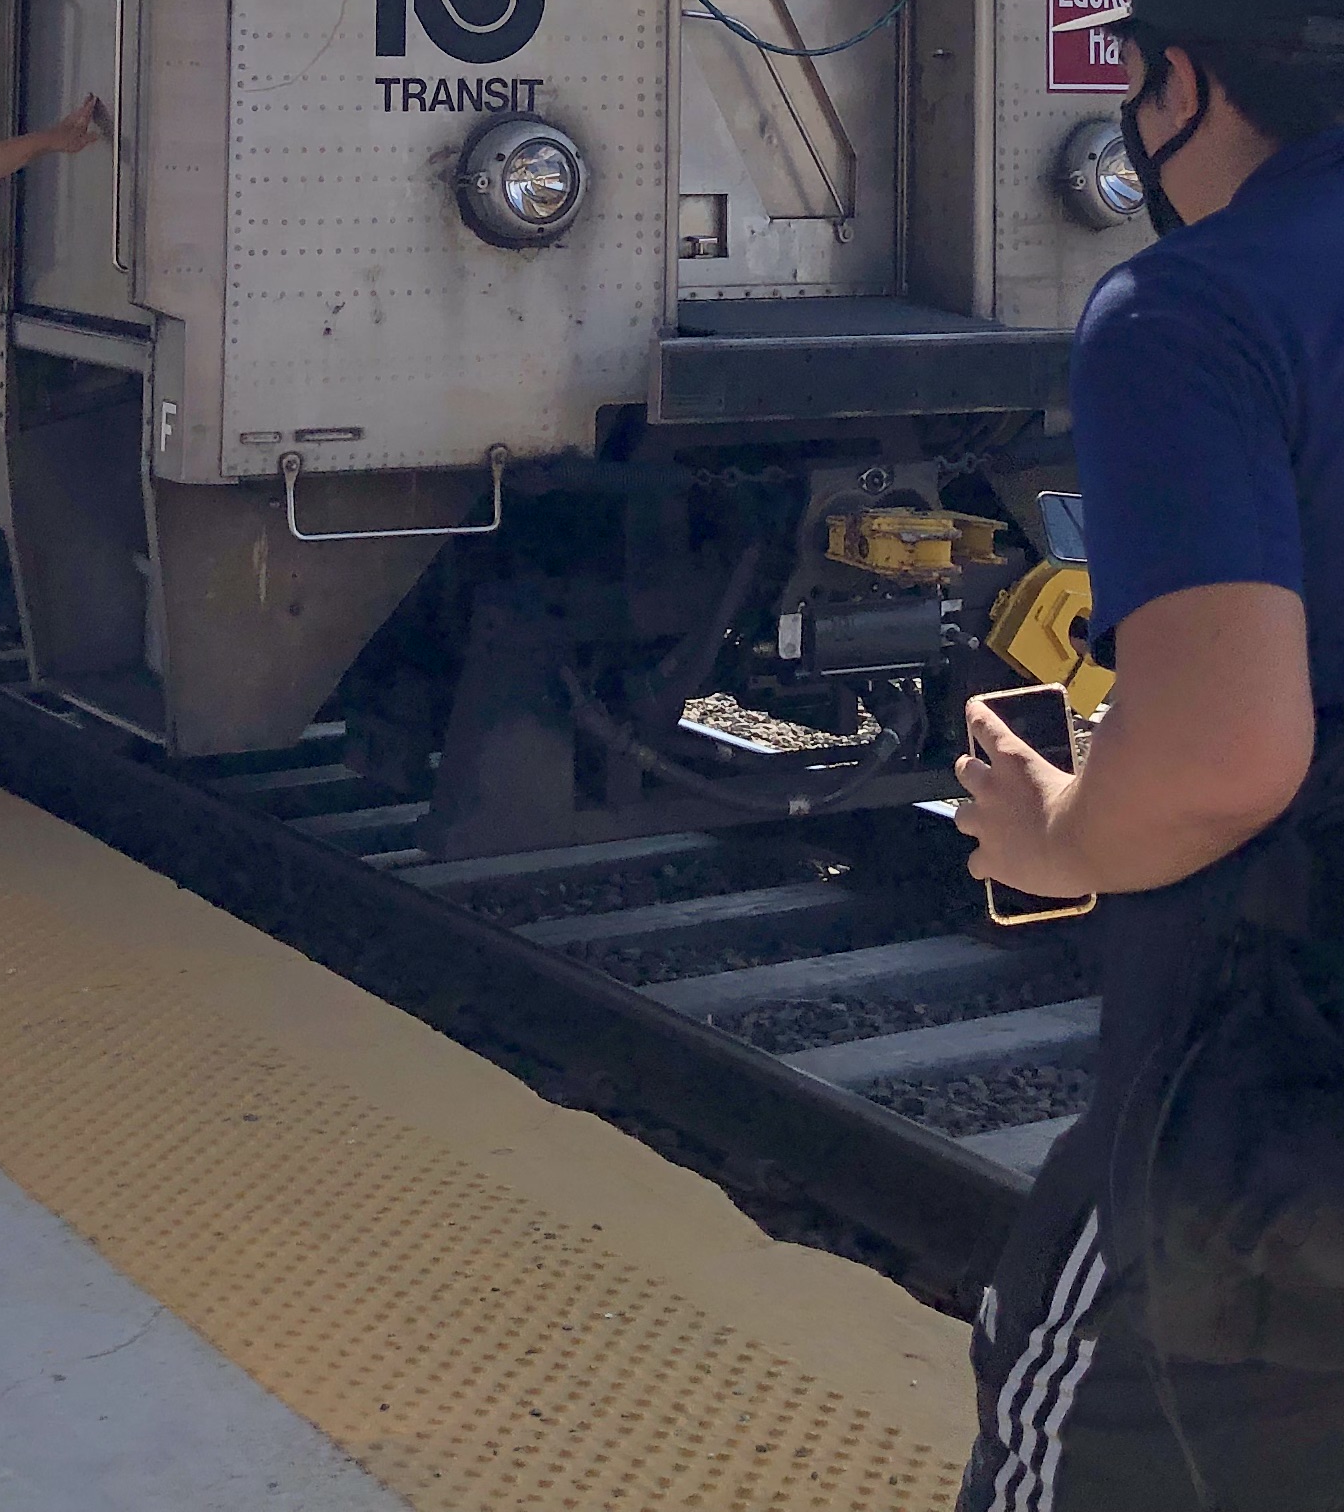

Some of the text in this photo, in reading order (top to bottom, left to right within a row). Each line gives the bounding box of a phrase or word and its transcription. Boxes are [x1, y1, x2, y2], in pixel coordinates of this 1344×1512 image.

[1089, 27, 1120, 65] Ra
[375, 77, 544, 113] TRANSIT
[160, 401, 177, 452] F
